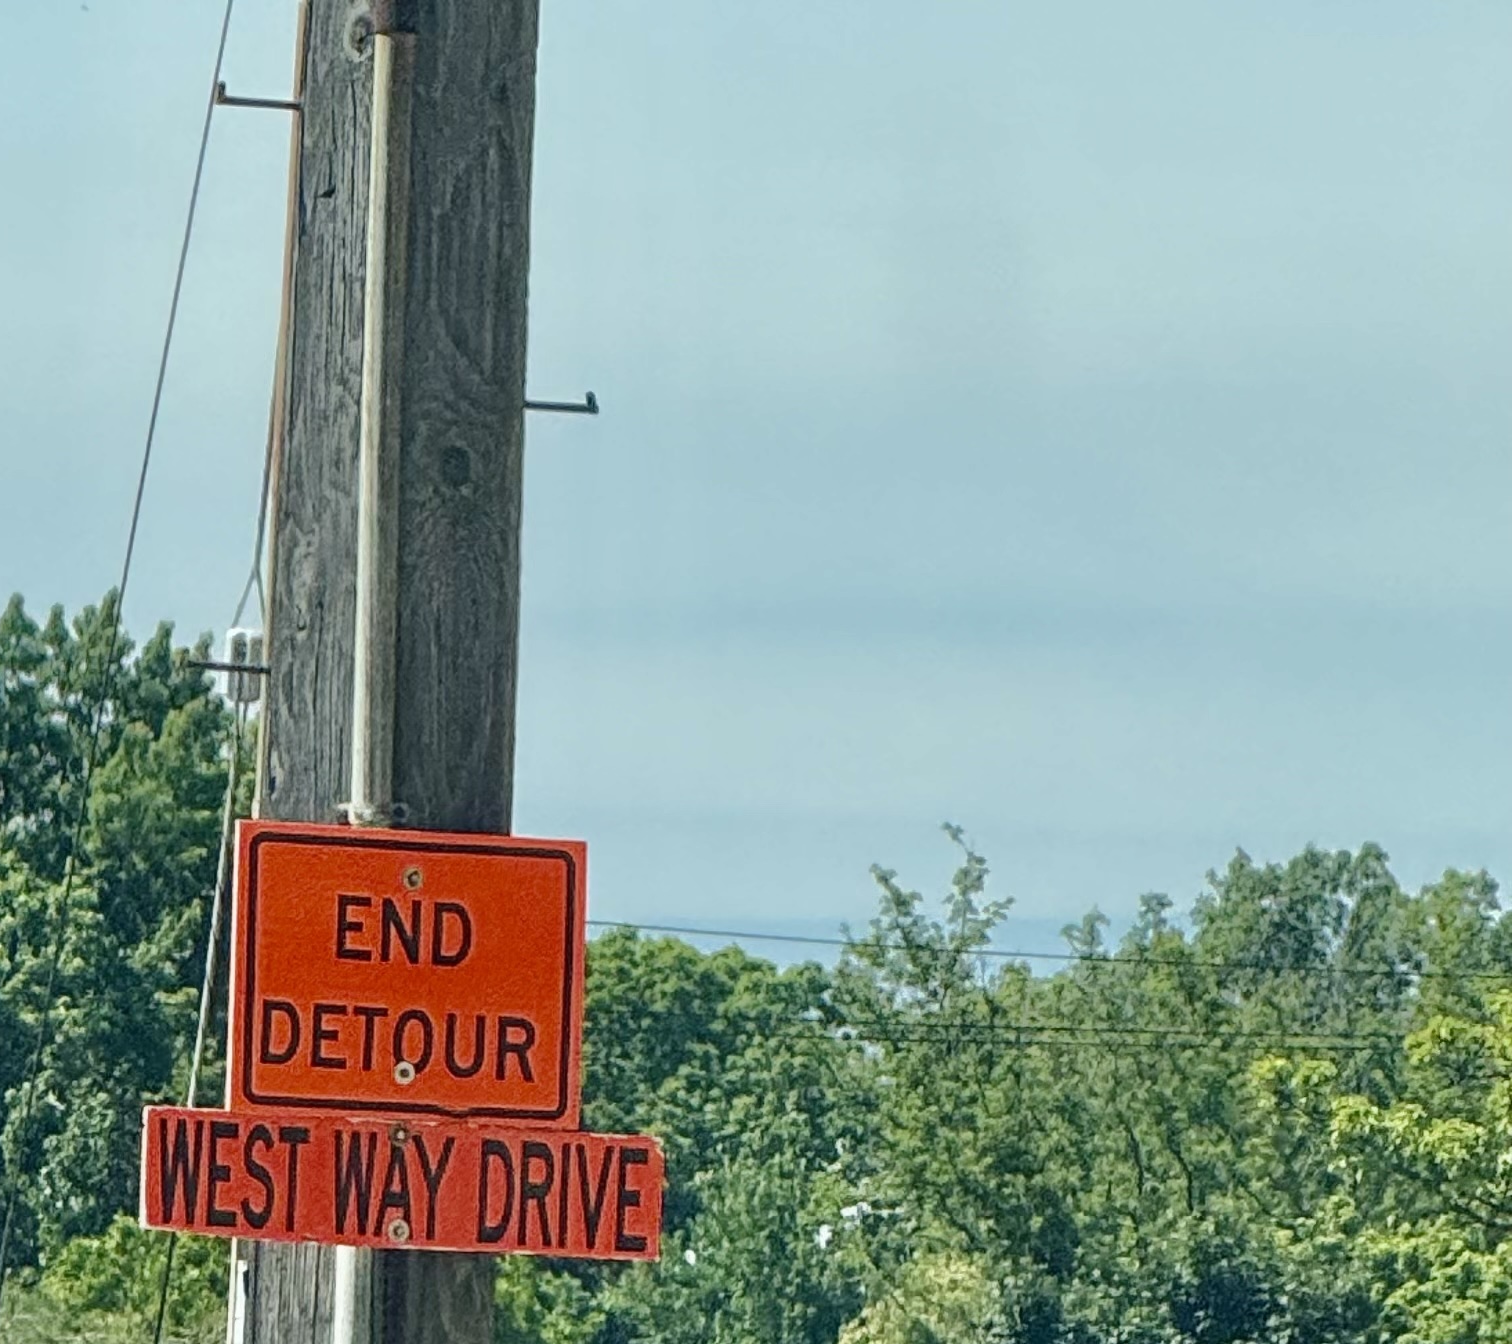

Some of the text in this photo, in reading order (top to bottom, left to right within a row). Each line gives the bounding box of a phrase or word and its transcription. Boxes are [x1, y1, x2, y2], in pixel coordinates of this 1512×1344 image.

[335, 894, 473, 968] END
[259, 999, 537, 1083] DETOUR
[159, 1117, 649, 1252] WEST WAY DRIVE
